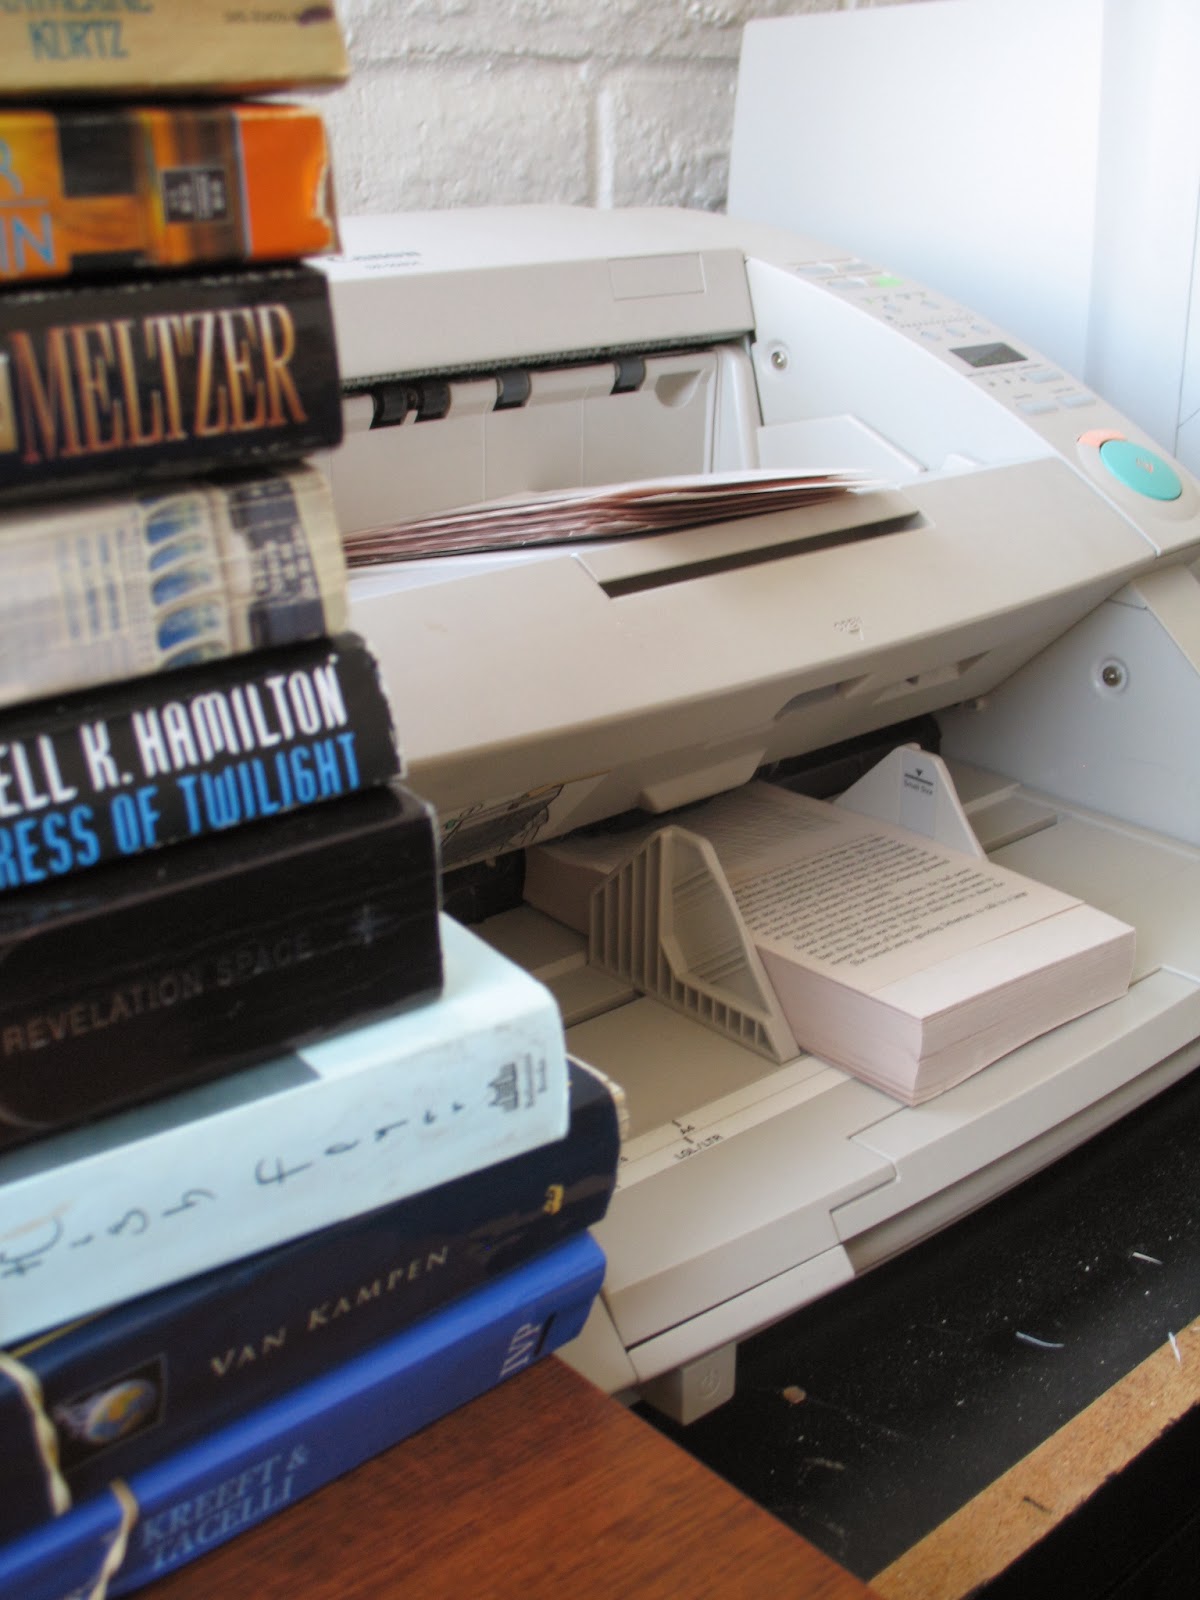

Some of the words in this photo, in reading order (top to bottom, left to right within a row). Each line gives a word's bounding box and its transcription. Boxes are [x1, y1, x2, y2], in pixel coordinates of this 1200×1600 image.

[10, 304, 308, 464] MELTZER
[79, 720, 133, 792] K.
[131, 663, 348, 778] HAMILTON
[110, 784, 161, 855] OF
[176, 731, 362, 836] TWILIGHT
[2, 965, 203, 1056] REVELATION
[216, 934, 313, 988] SPACE
[210, 1325, 287, 1376] VAN
[307, 1245, 449, 1332] KAMPEN
